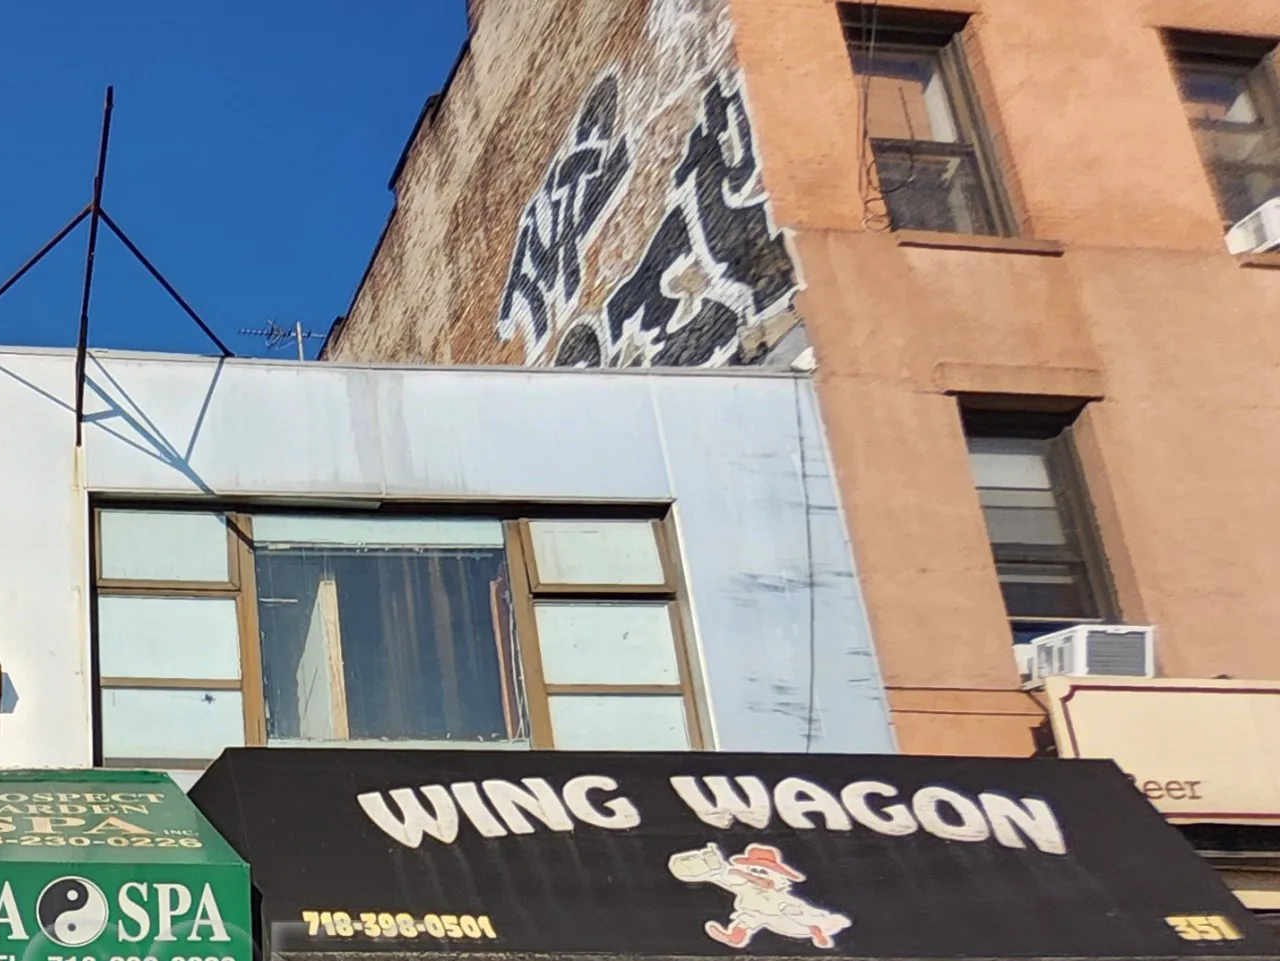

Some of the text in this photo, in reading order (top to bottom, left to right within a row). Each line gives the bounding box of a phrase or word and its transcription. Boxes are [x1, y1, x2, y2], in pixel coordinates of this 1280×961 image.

[1123, 772, 1204, 800] eer
[357, 775, 1067, 856] WING WAGON
[117, 881, 232, 943] SPA
[301, 910, 498, 940] 718-398-0501
[1163, 914, 1245, 942] 351
